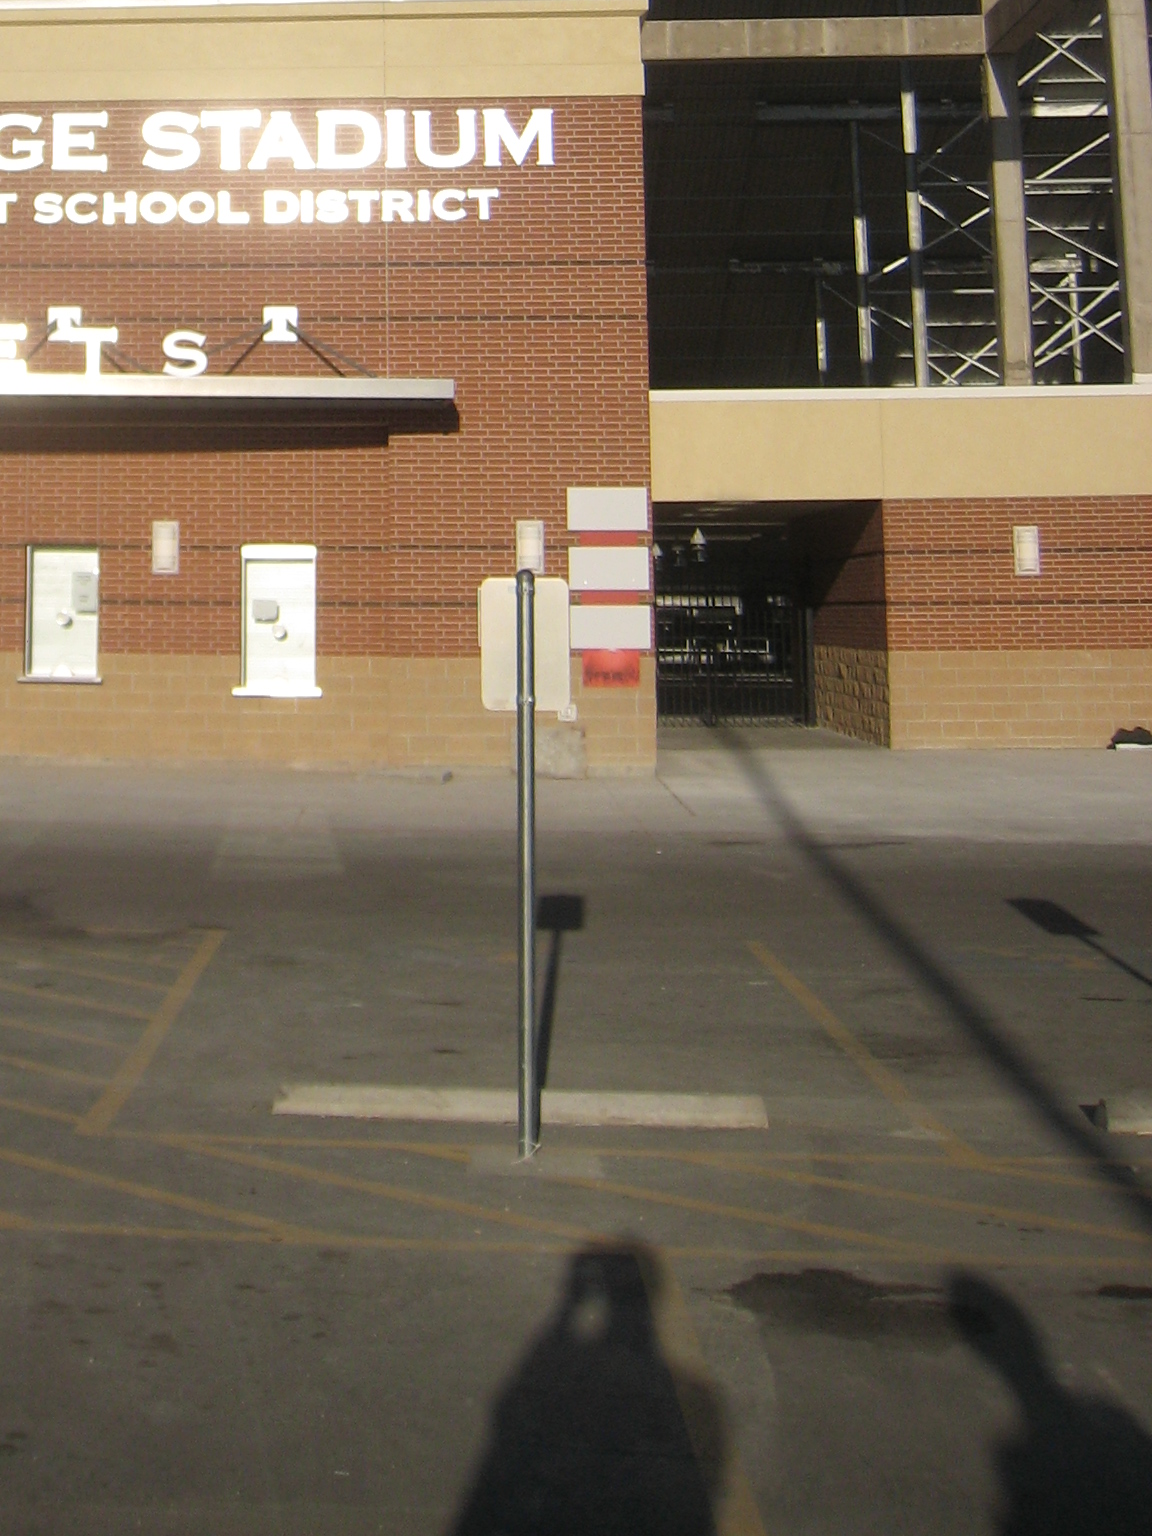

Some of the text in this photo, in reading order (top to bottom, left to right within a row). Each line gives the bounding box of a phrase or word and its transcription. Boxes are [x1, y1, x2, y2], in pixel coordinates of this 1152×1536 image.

[141, 108, 556, 171] STADIUM
[33, 191, 250, 225] SCHOOL
[263, 188, 499, 224] DISTRICT
